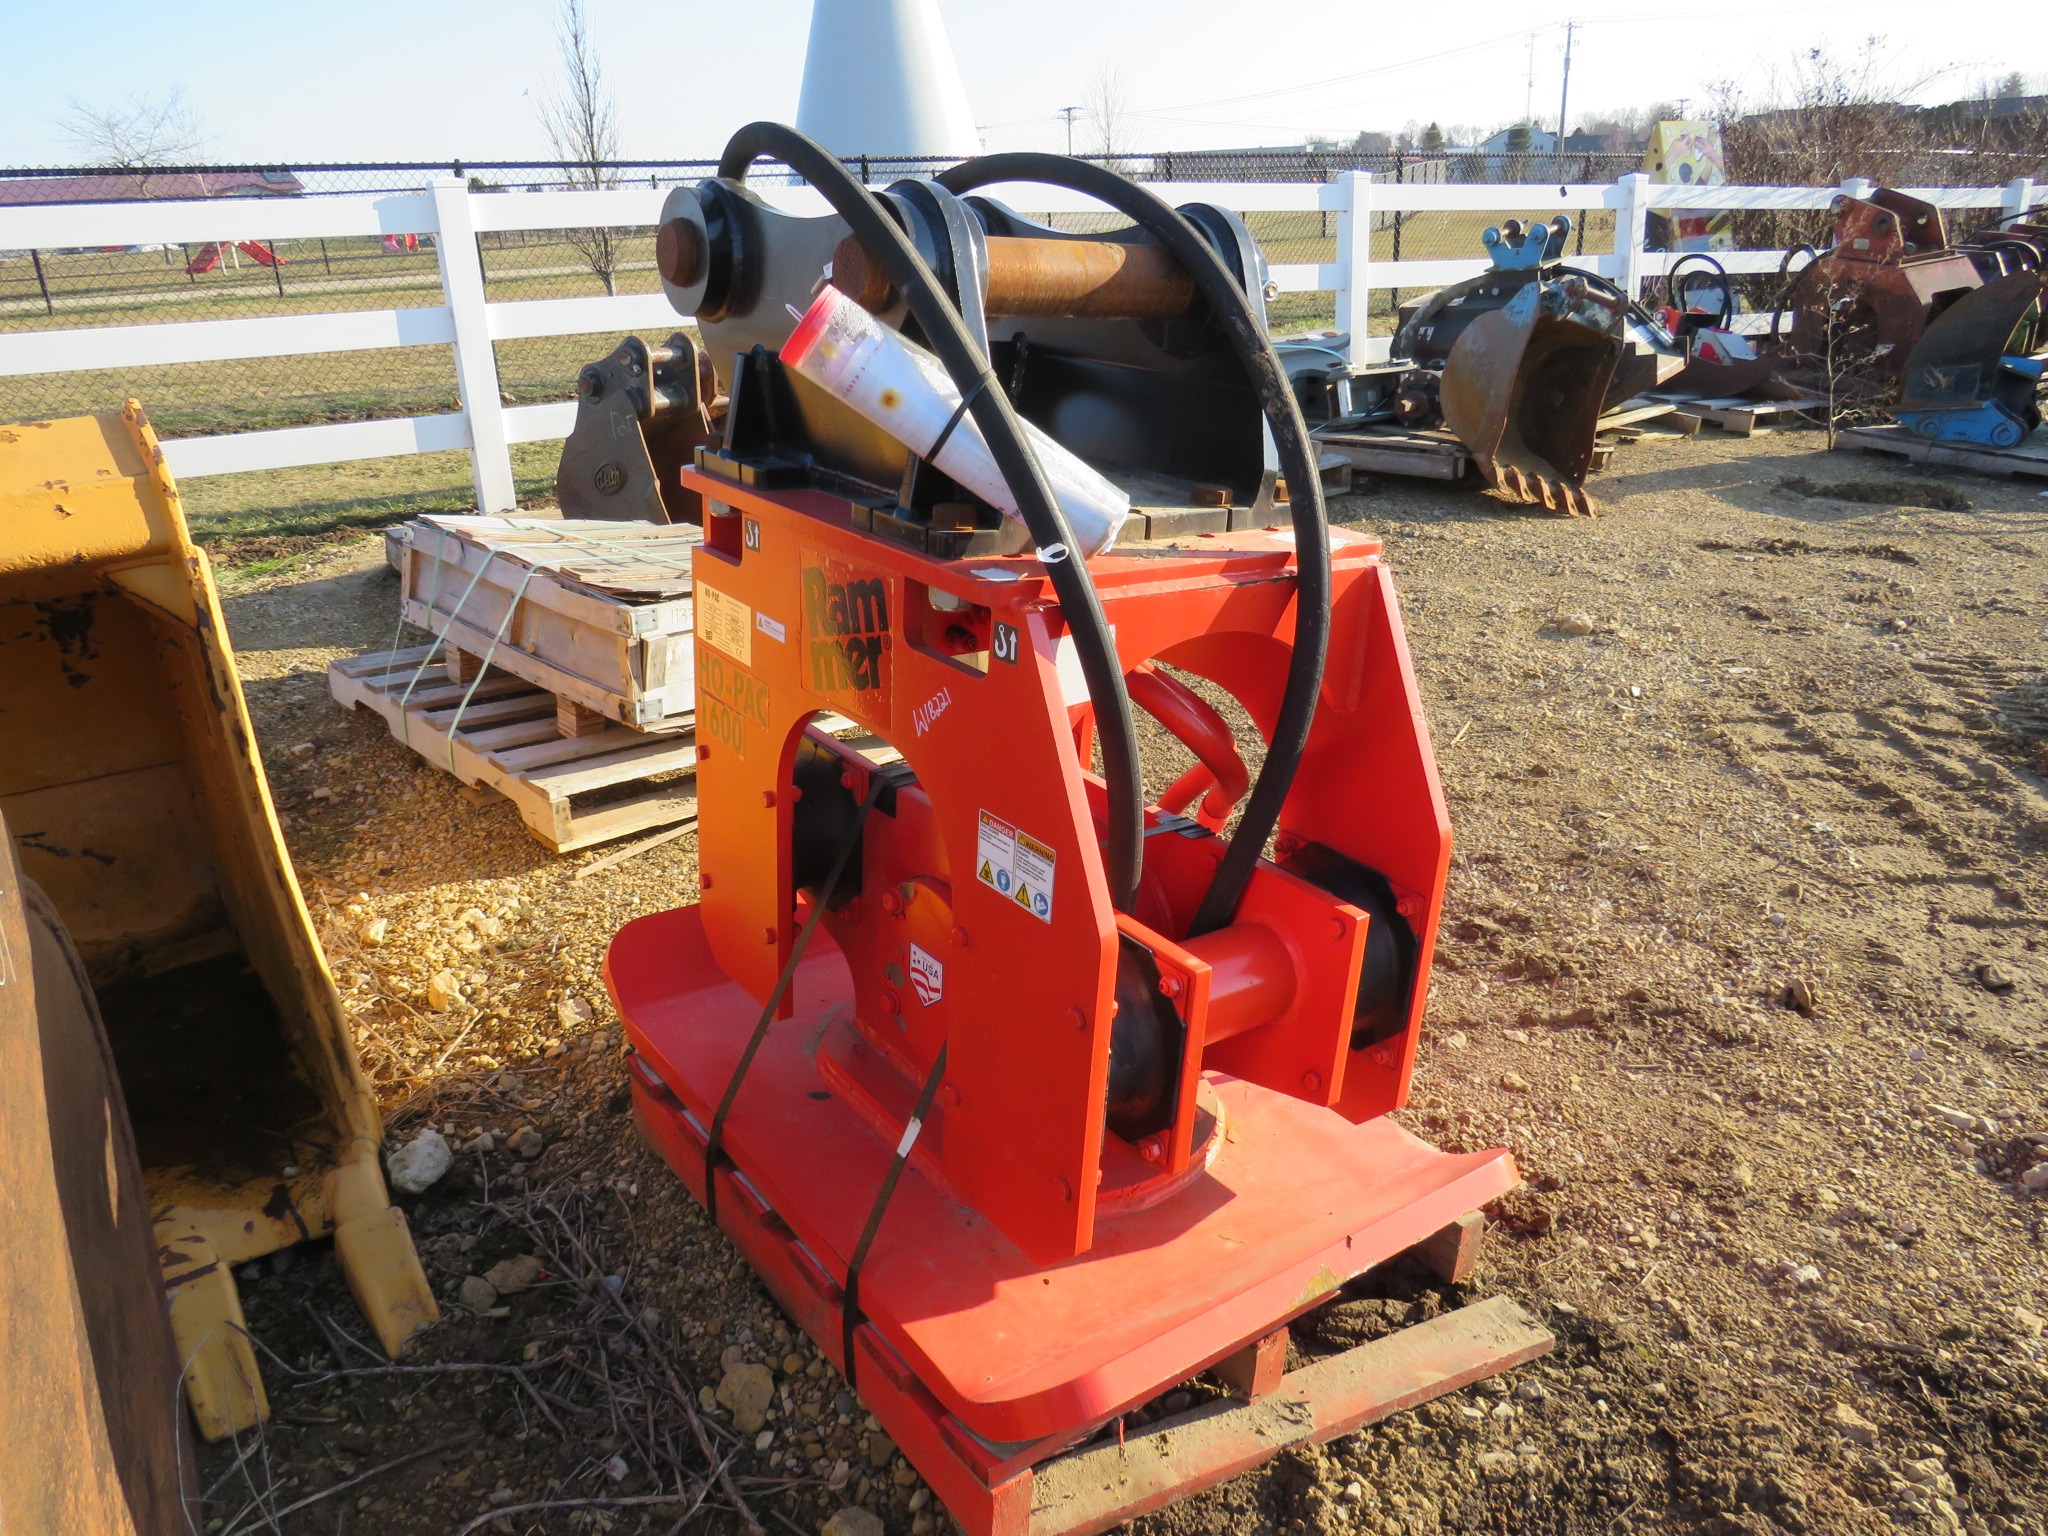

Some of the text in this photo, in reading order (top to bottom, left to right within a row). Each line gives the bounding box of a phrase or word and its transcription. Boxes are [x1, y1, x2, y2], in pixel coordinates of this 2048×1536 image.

[802, 567, 889, 638] Ram
[698, 648, 768, 729] HO-PAC
[699, 689, 743, 755] 1600
[988, 819, 1014, 839] DANGER
[1025, 840, 1055, 863] WARNING
[922, 960, 939, 980] USA
